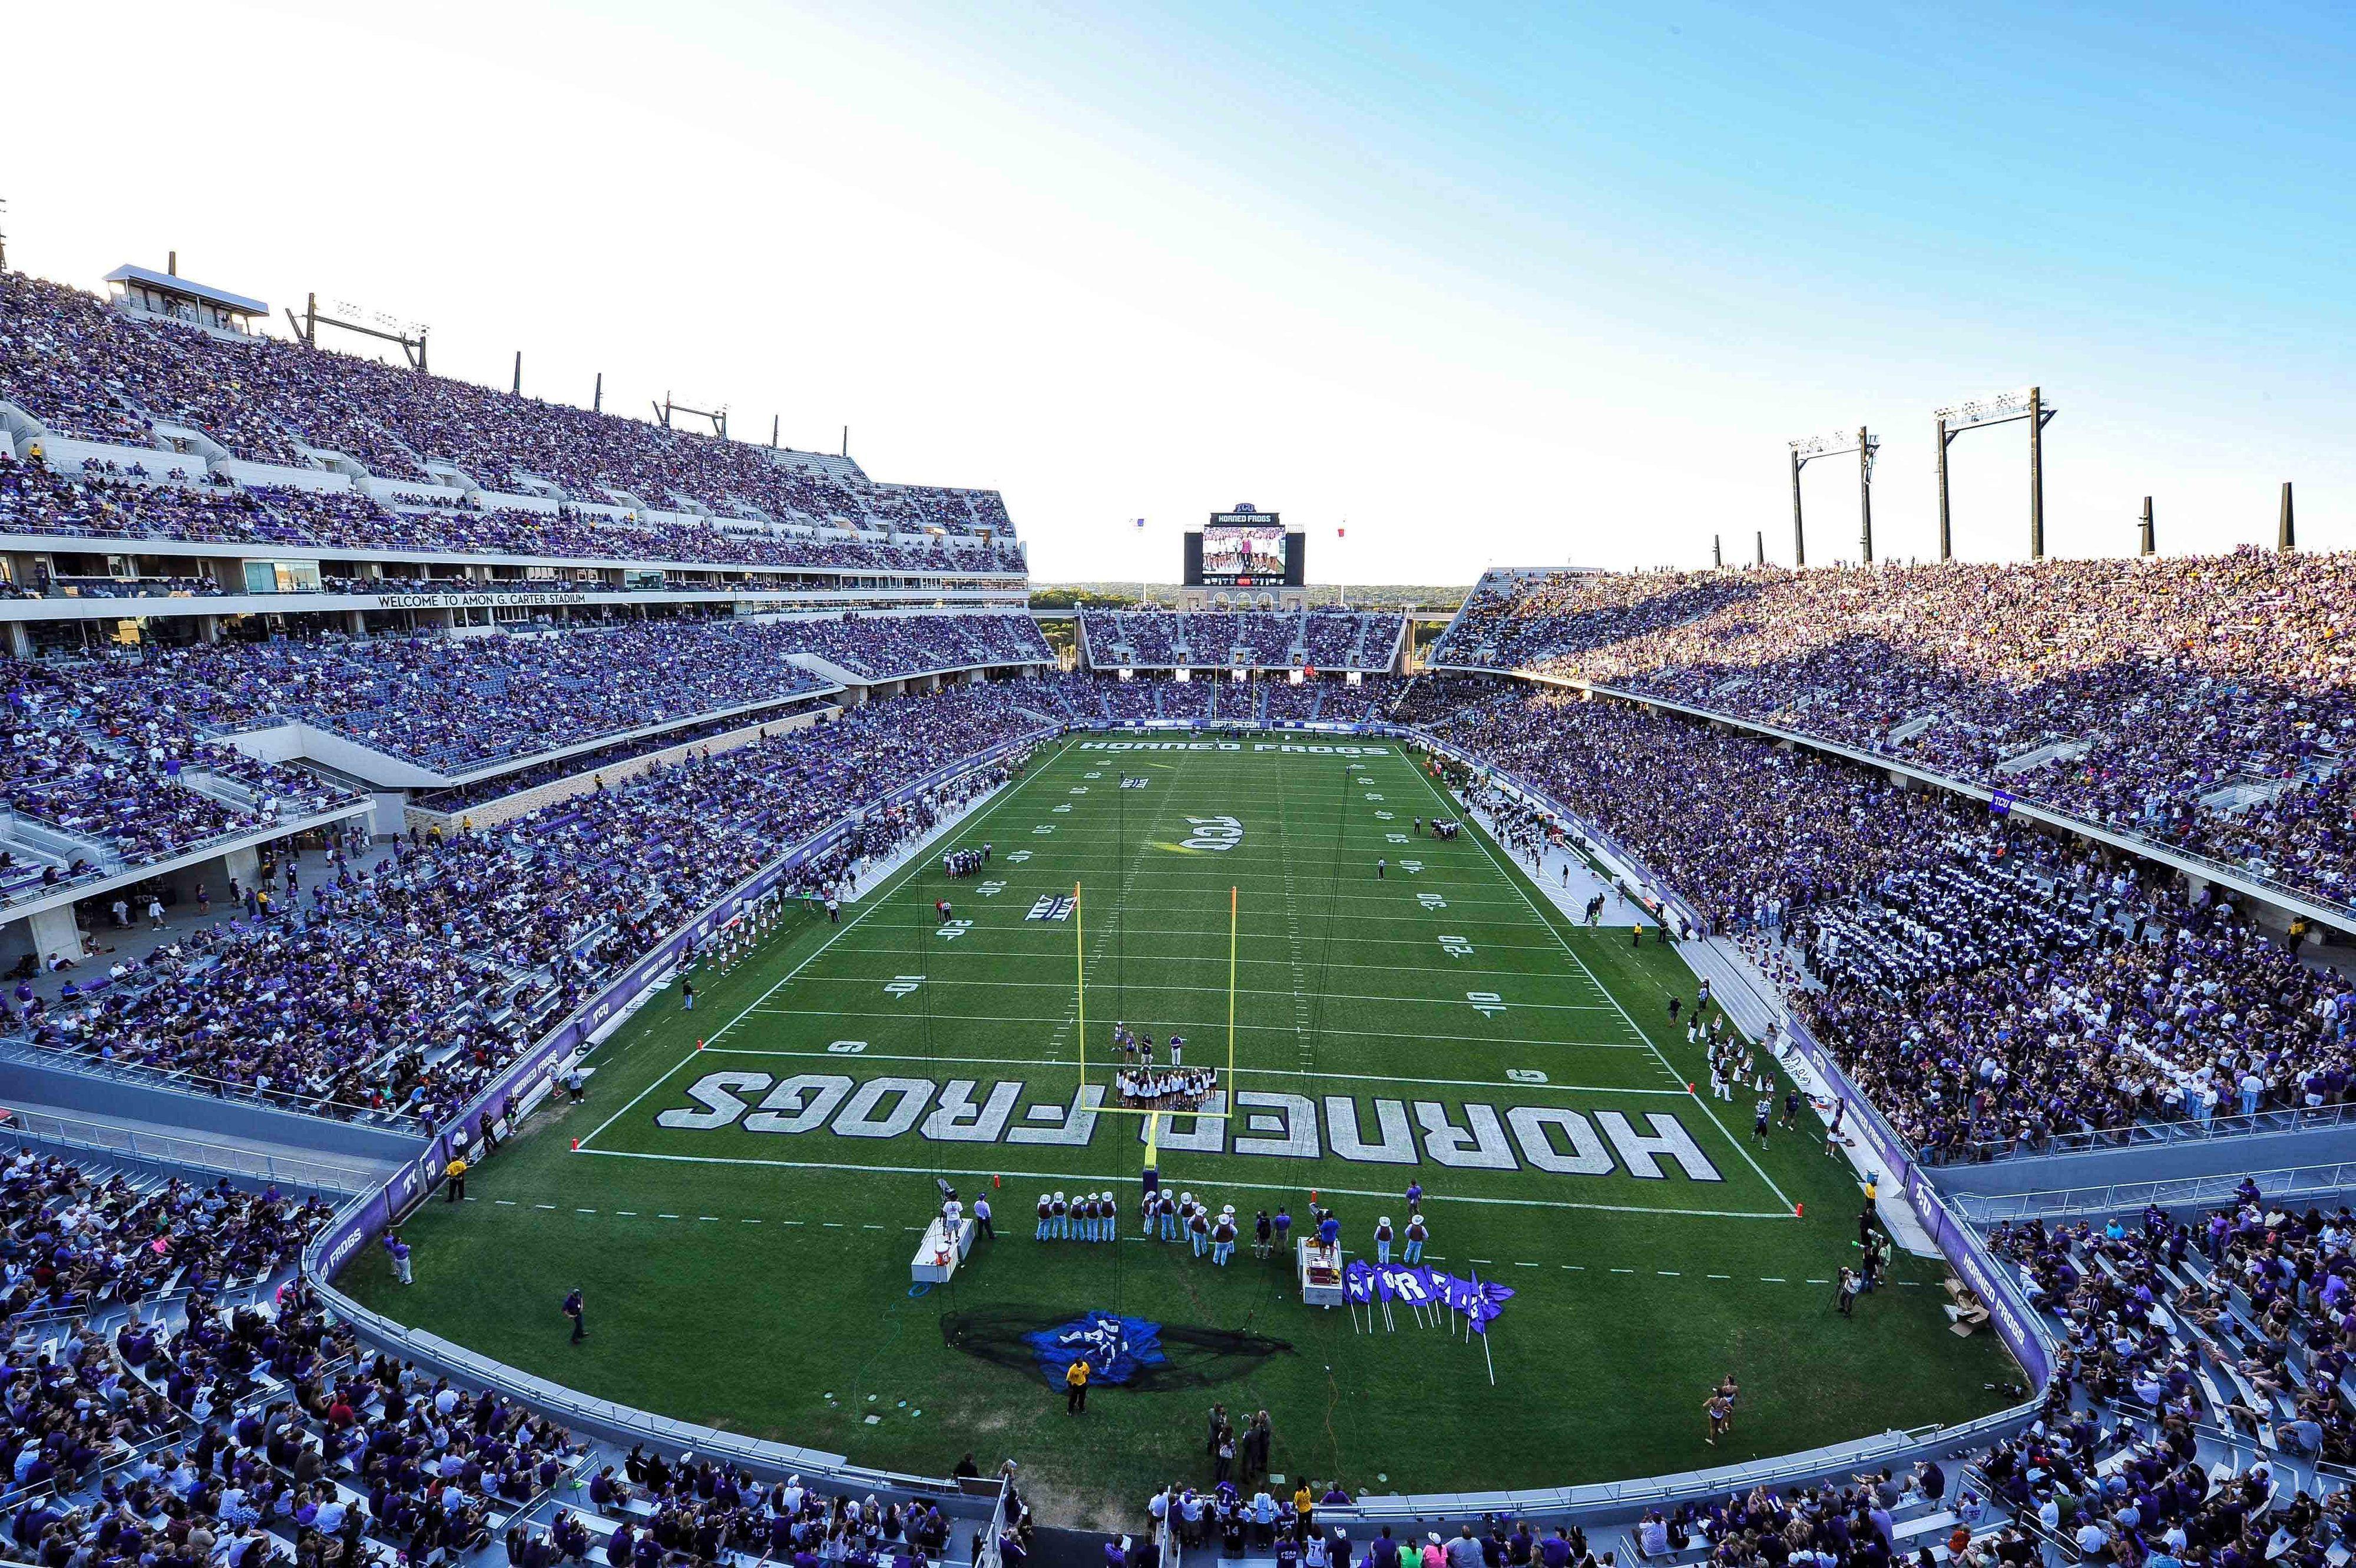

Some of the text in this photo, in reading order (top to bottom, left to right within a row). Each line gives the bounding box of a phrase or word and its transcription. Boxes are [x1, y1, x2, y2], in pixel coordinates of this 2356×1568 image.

[378, 594, 585, 607] WELCOME TO AMON G. CARTER STADIUM
[1080, 742, 1241, 750] HORNED
[1254, 743, 1389, 755] FROGS
[1994, 796, 2010, 808] TCU
[1032, 825, 1056, 833] 50
[1179, 816, 1243, 850] TCU
[1385, 833, 1409, 843] 50
[1007, 851, 1033, 860] 40
[1399, 861, 1425, 872] 40
[976, 881, 1007, 894] 30
[1417, 893, 1447, 908] 30
[936, 919, 974, 937] 20
[1438, 936, 1474, 954] 20
[884, 975, 926, 992] 10
[1467, 992, 1507, 1011] 10
[593, 1003, 609, 1024] TCU
[828, 1040, 868, 1053] G
[1812, 1050, 1826, 1073] TCU
[511, 1050, 557, 1098] HORNED FROGS
[1507, 1069, 1548, 1083] G
[655, 1071, 1723, 1182] HORNED FROGS
[1848, 1098, 1887, 1155] HORNED FROGS
[330, 1227, 362, 1268] FROGS
[1963, 1252, 2025, 1345] HORNED FROGS
[1768, 1496, 1785, 1513] 14
[752, 1527, 765, 1537] 43
[1225, 1524, 1239, 1536] 14
[1675, 1524, 1689, 1539] 14
[1311, 1545, 1322, 1557] 71
